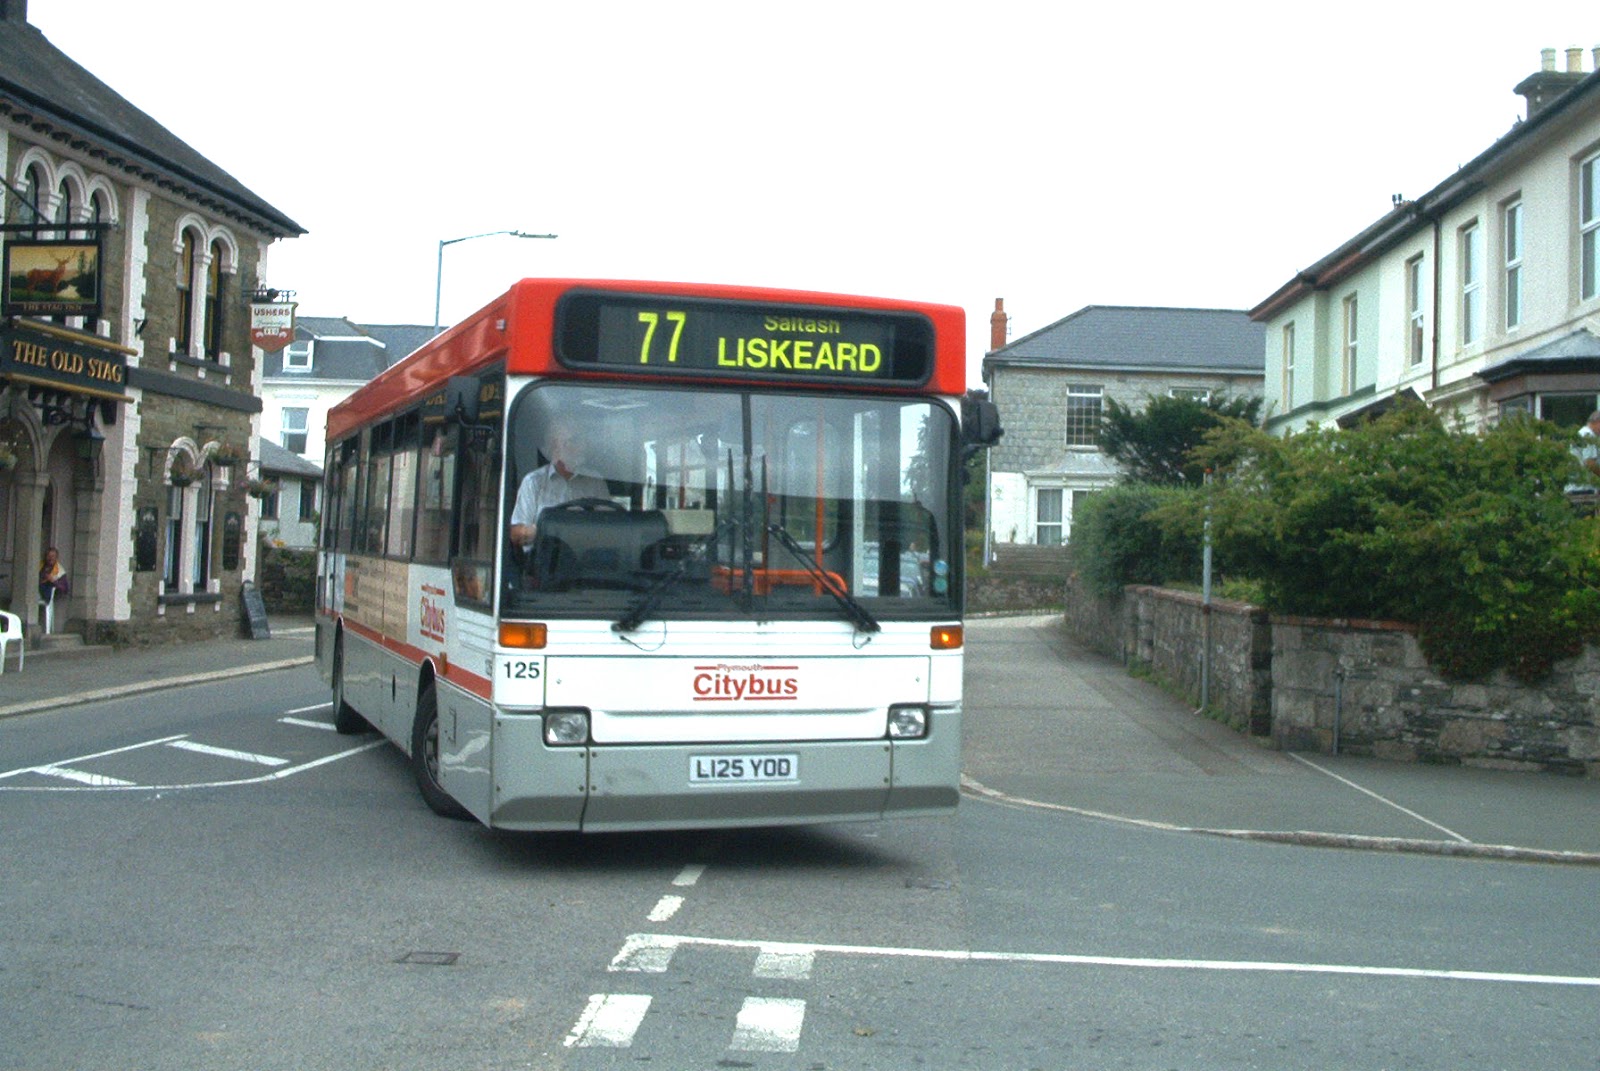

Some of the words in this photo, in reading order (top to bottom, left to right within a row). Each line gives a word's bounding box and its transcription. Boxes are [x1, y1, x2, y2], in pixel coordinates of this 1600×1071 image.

[254, 308, 290, 316] USHERS
[764, 315, 840, 334] Saltash
[638, 311, 687, 364] 77
[13, 340, 47, 368] THE
[51, 349, 84, 374] OLD
[87, 357, 122, 383] STAG
[717, 337, 882, 372] LISKEARD
[503, 660, 540, 679] 125
[716, 663, 763, 673] Plymouth
[693, 673, 798, 701] Citybus
[697, 759, 745, 778] L125
[750, 758, 791, 777] YOD
